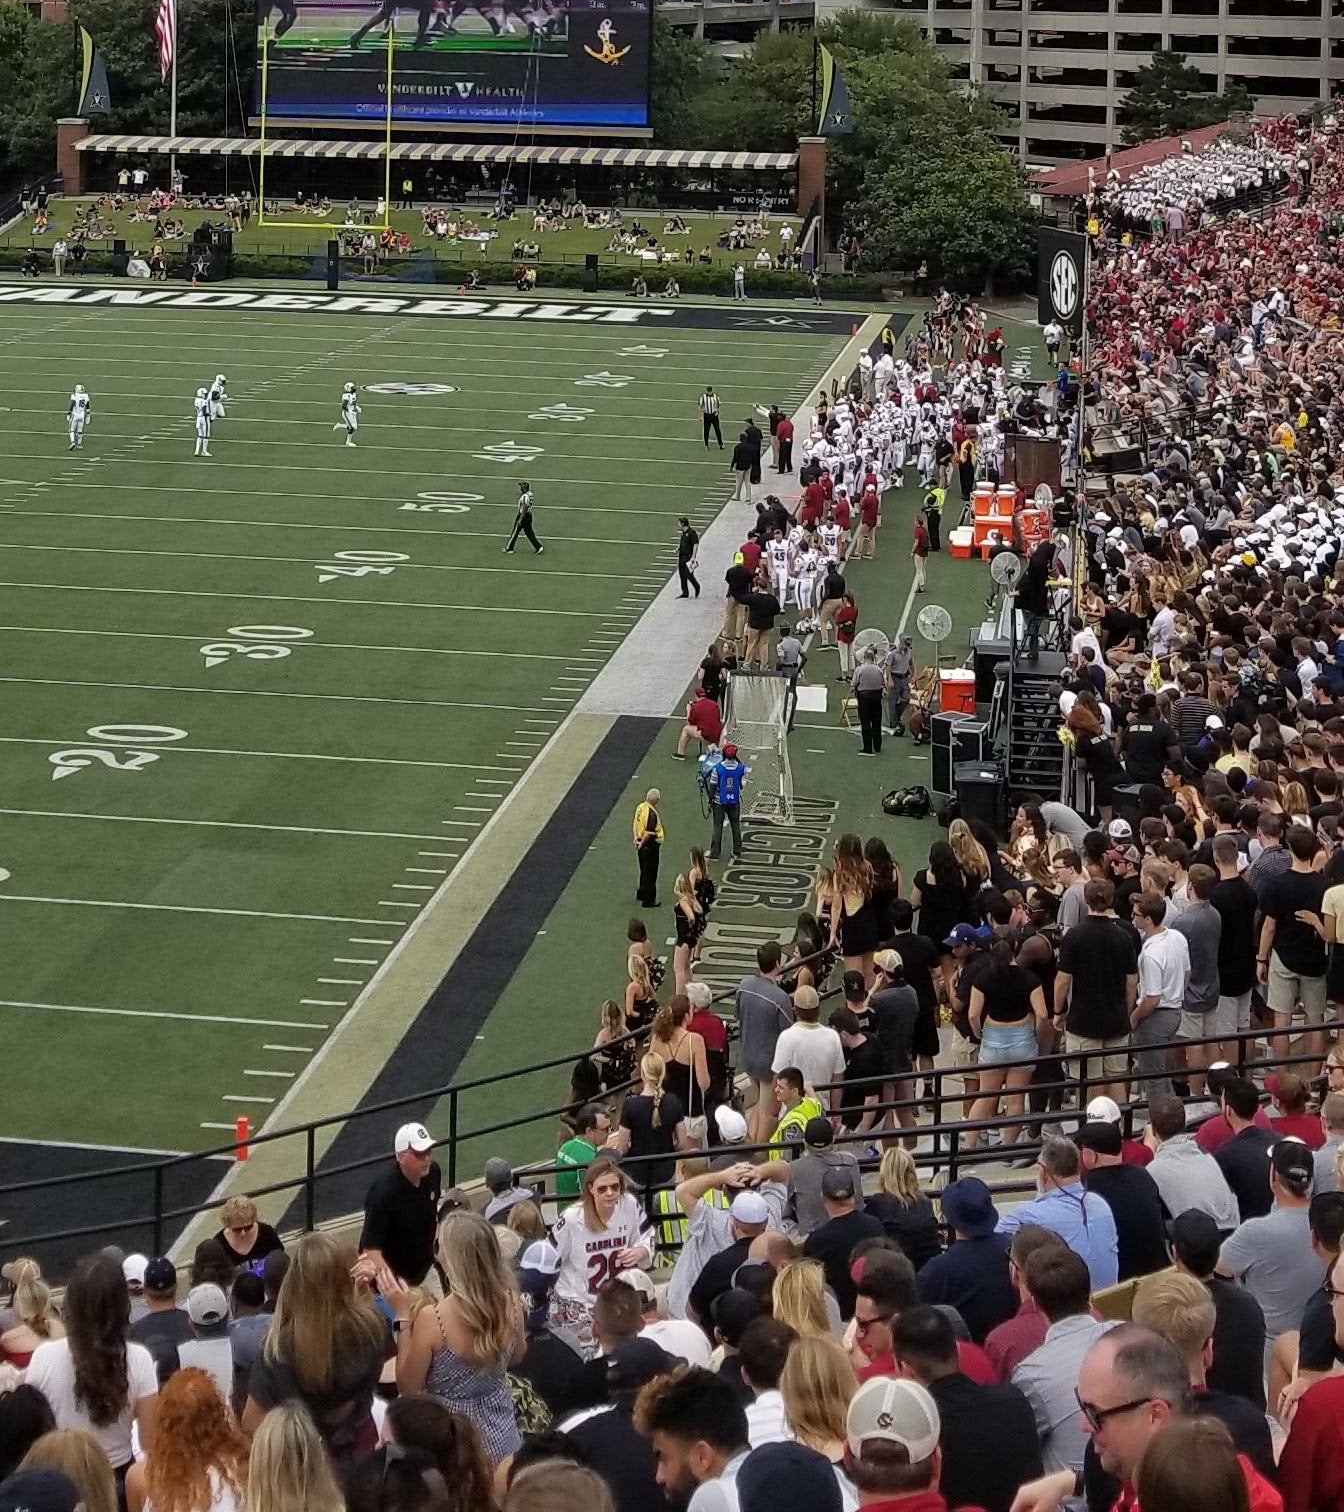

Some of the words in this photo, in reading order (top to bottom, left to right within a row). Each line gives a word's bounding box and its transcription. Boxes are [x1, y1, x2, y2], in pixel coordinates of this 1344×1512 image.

[1052, 254, 1077, 316] SEC
[527, 405, 596, 422] 30
[471, 443, 545, 463] 40
[396, 491, 486, 514] 50
[314, 550, 411, 576] 40
[199, 625, 315, 660] 30
[48, 724, 189, 772] 20
[585, 1235, 627, 1254] CAROLINA
